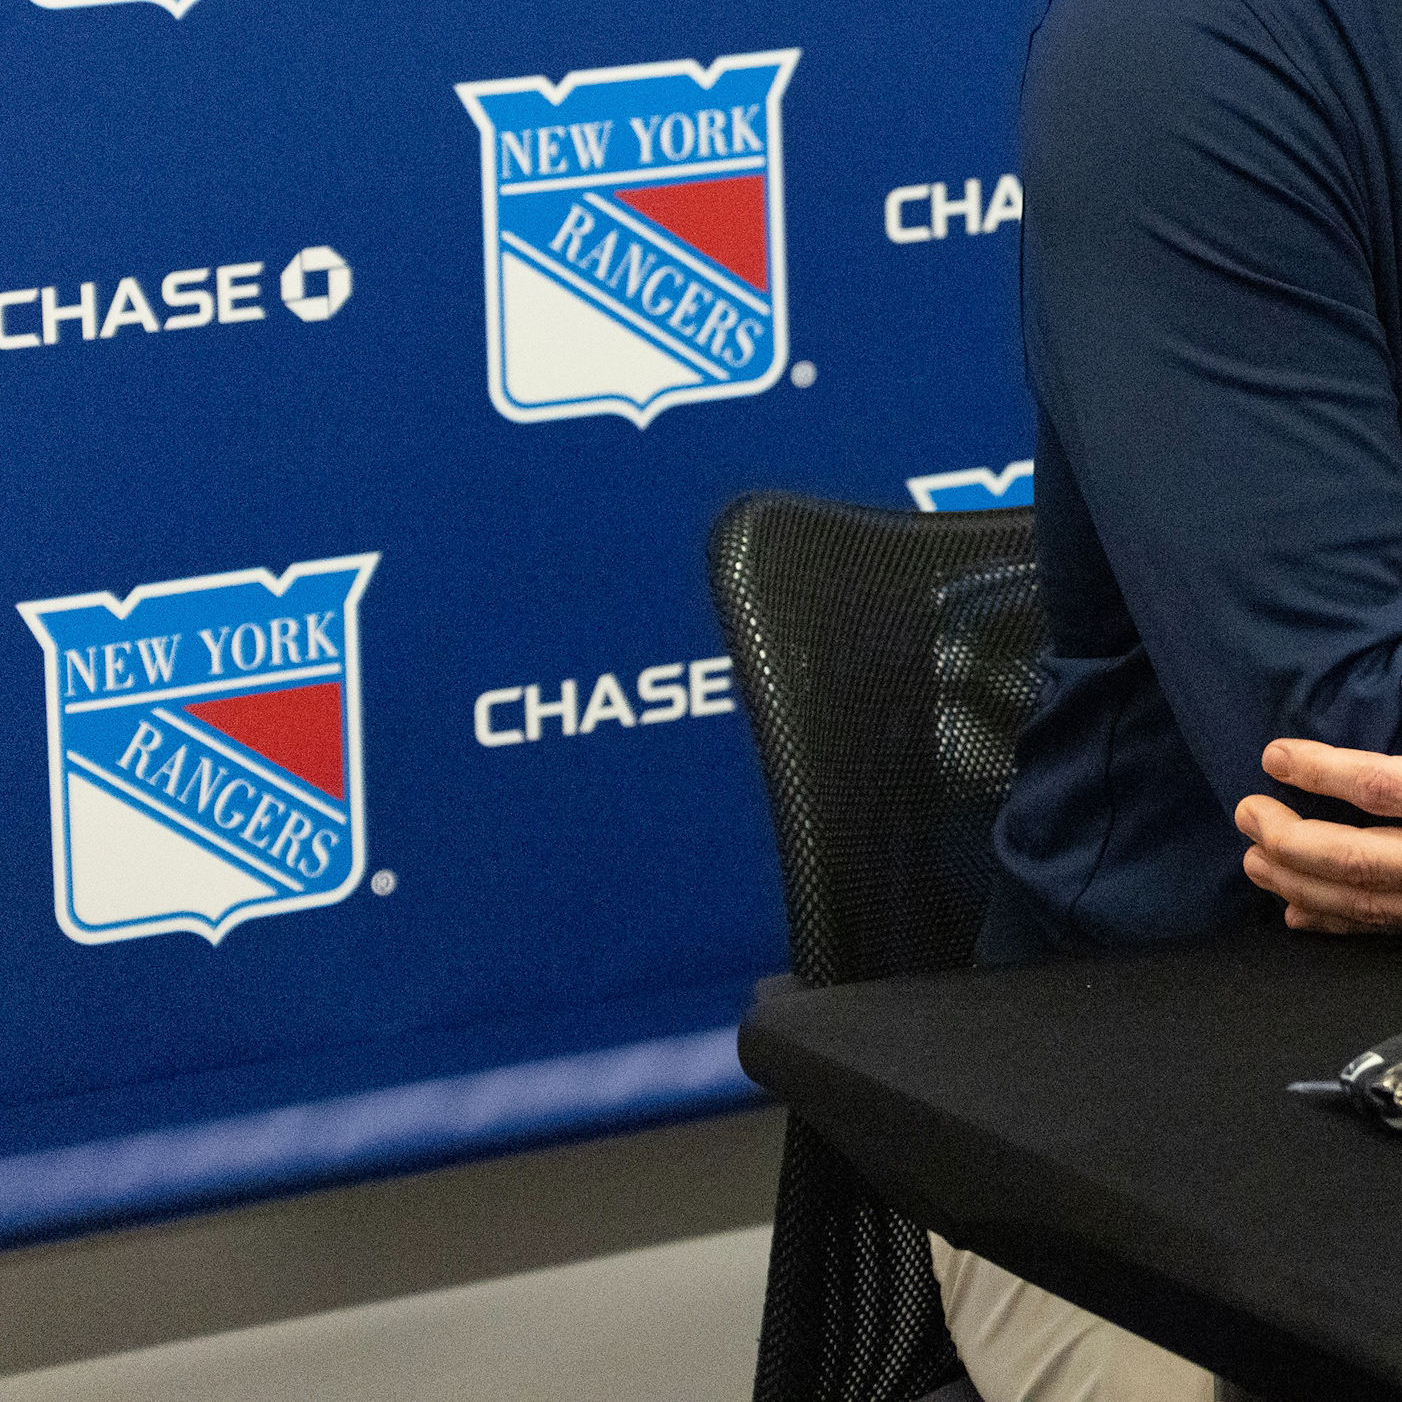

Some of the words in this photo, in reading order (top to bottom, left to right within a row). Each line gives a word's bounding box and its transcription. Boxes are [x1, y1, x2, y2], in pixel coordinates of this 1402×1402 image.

[499, 120, 612, 179] NEW
[628, 105, 764, 165] YORK
[885, 174, 1023, 244] CHA
[0, 261, 265, 349] CHASE
[549, 203, 764, 366] RANGERS
[63, 633, 181, 697] NEW
[198, 610, 340, 677] YORK
[474, 656, 734, 746] CHASE
[116, 719, 341, 878] RANGERS
